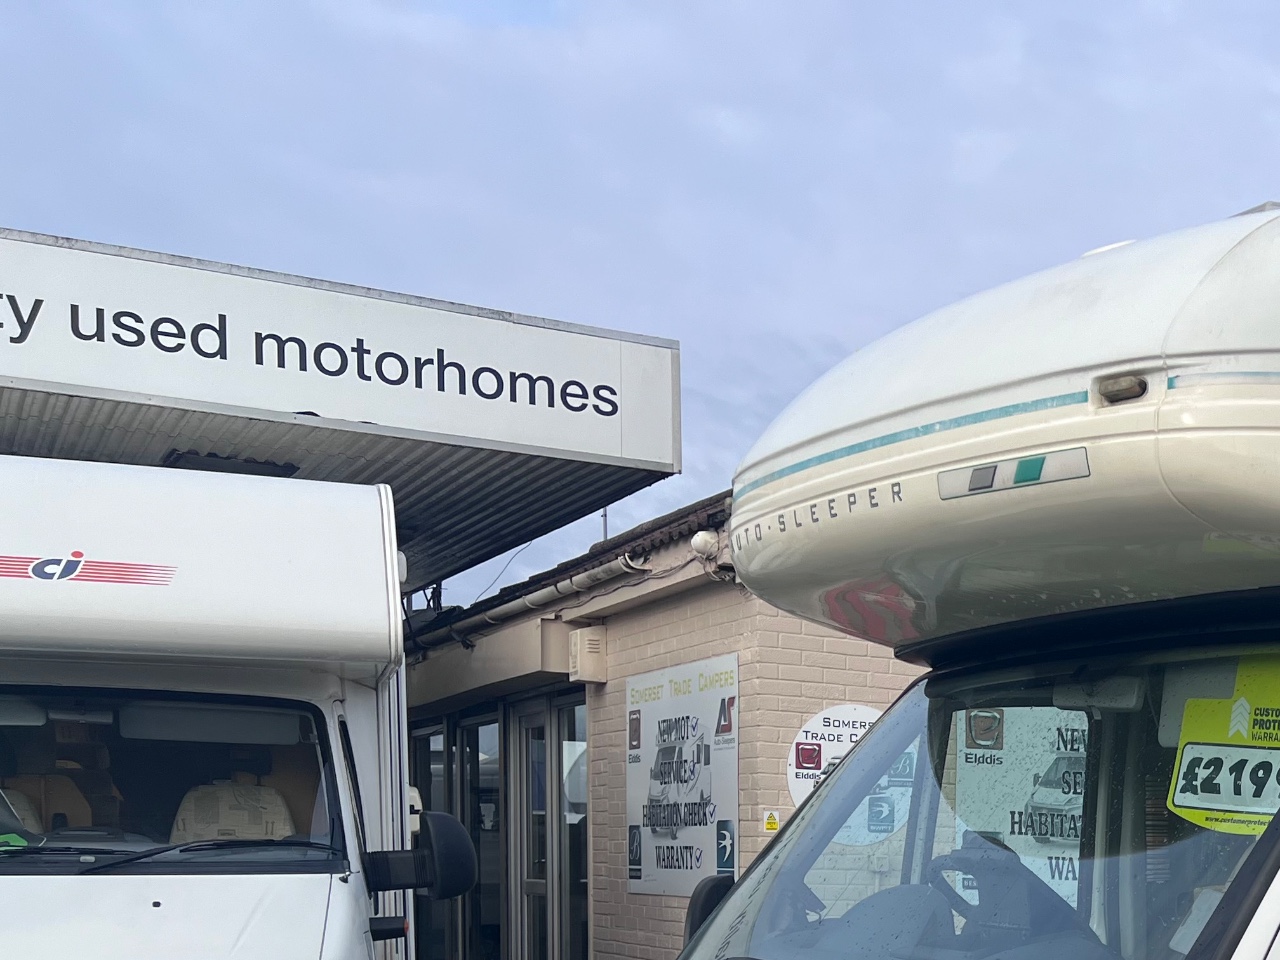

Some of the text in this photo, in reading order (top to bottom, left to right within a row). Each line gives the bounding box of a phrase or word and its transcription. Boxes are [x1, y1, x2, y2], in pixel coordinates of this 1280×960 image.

[70, 303, 228, 360] used
[254, 331, 620, 417] motorhomes
[803, 730, 844, 743] TRADE
[964, 752, 1004, 765] Elddis
[660, 760, 688, 785] SERVICE
[795, 771, 822, 780] Elddis
[683, 802, 708, 826] CHECK
[655, 846, 694, 870] WARRANTY
